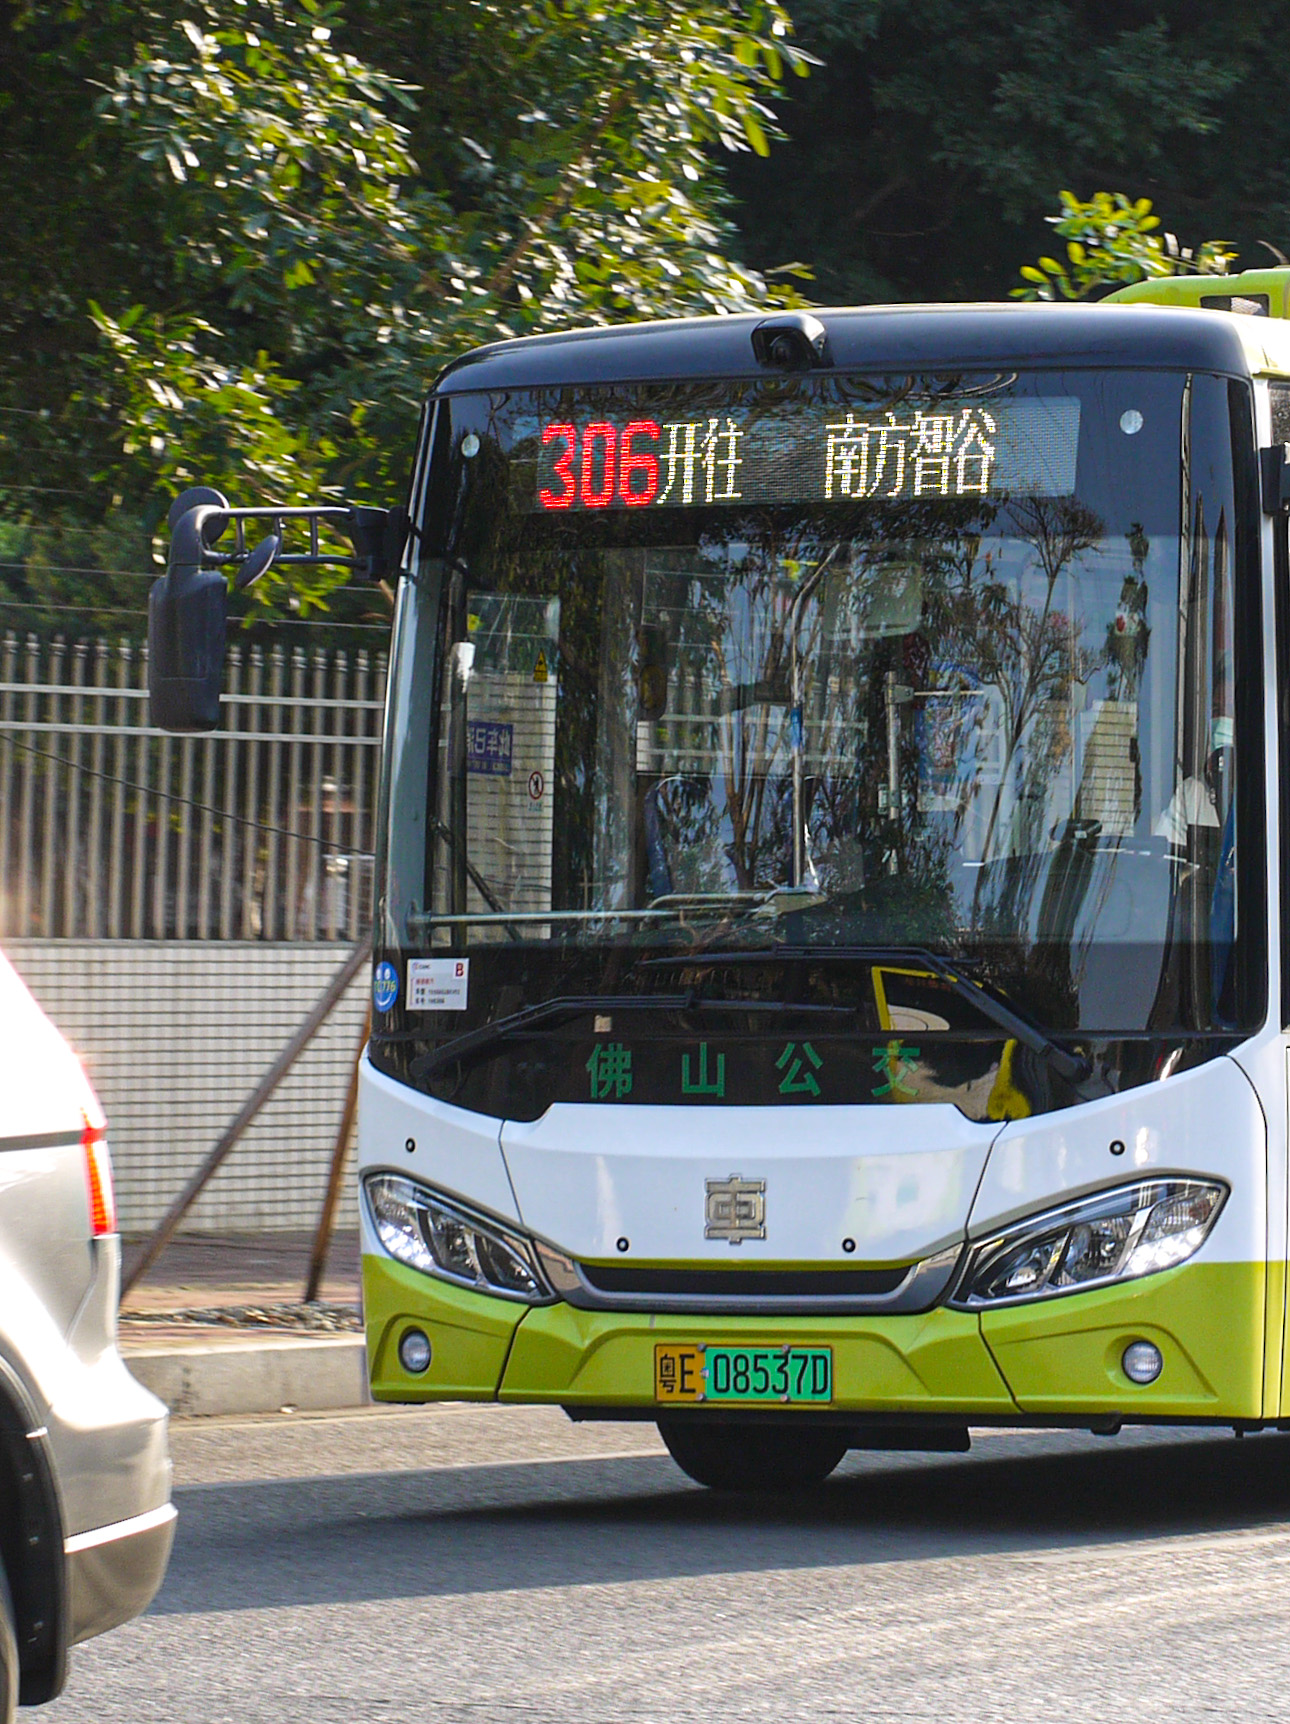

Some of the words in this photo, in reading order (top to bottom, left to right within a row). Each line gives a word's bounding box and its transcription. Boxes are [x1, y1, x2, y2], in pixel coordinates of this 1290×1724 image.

[538, 420, 661, 508] 306
[657, 418, 744, 504] 开往
[824, 408, 996, 499] 南方智谷
[585, 1041, 922, 1098] 佛山公交
